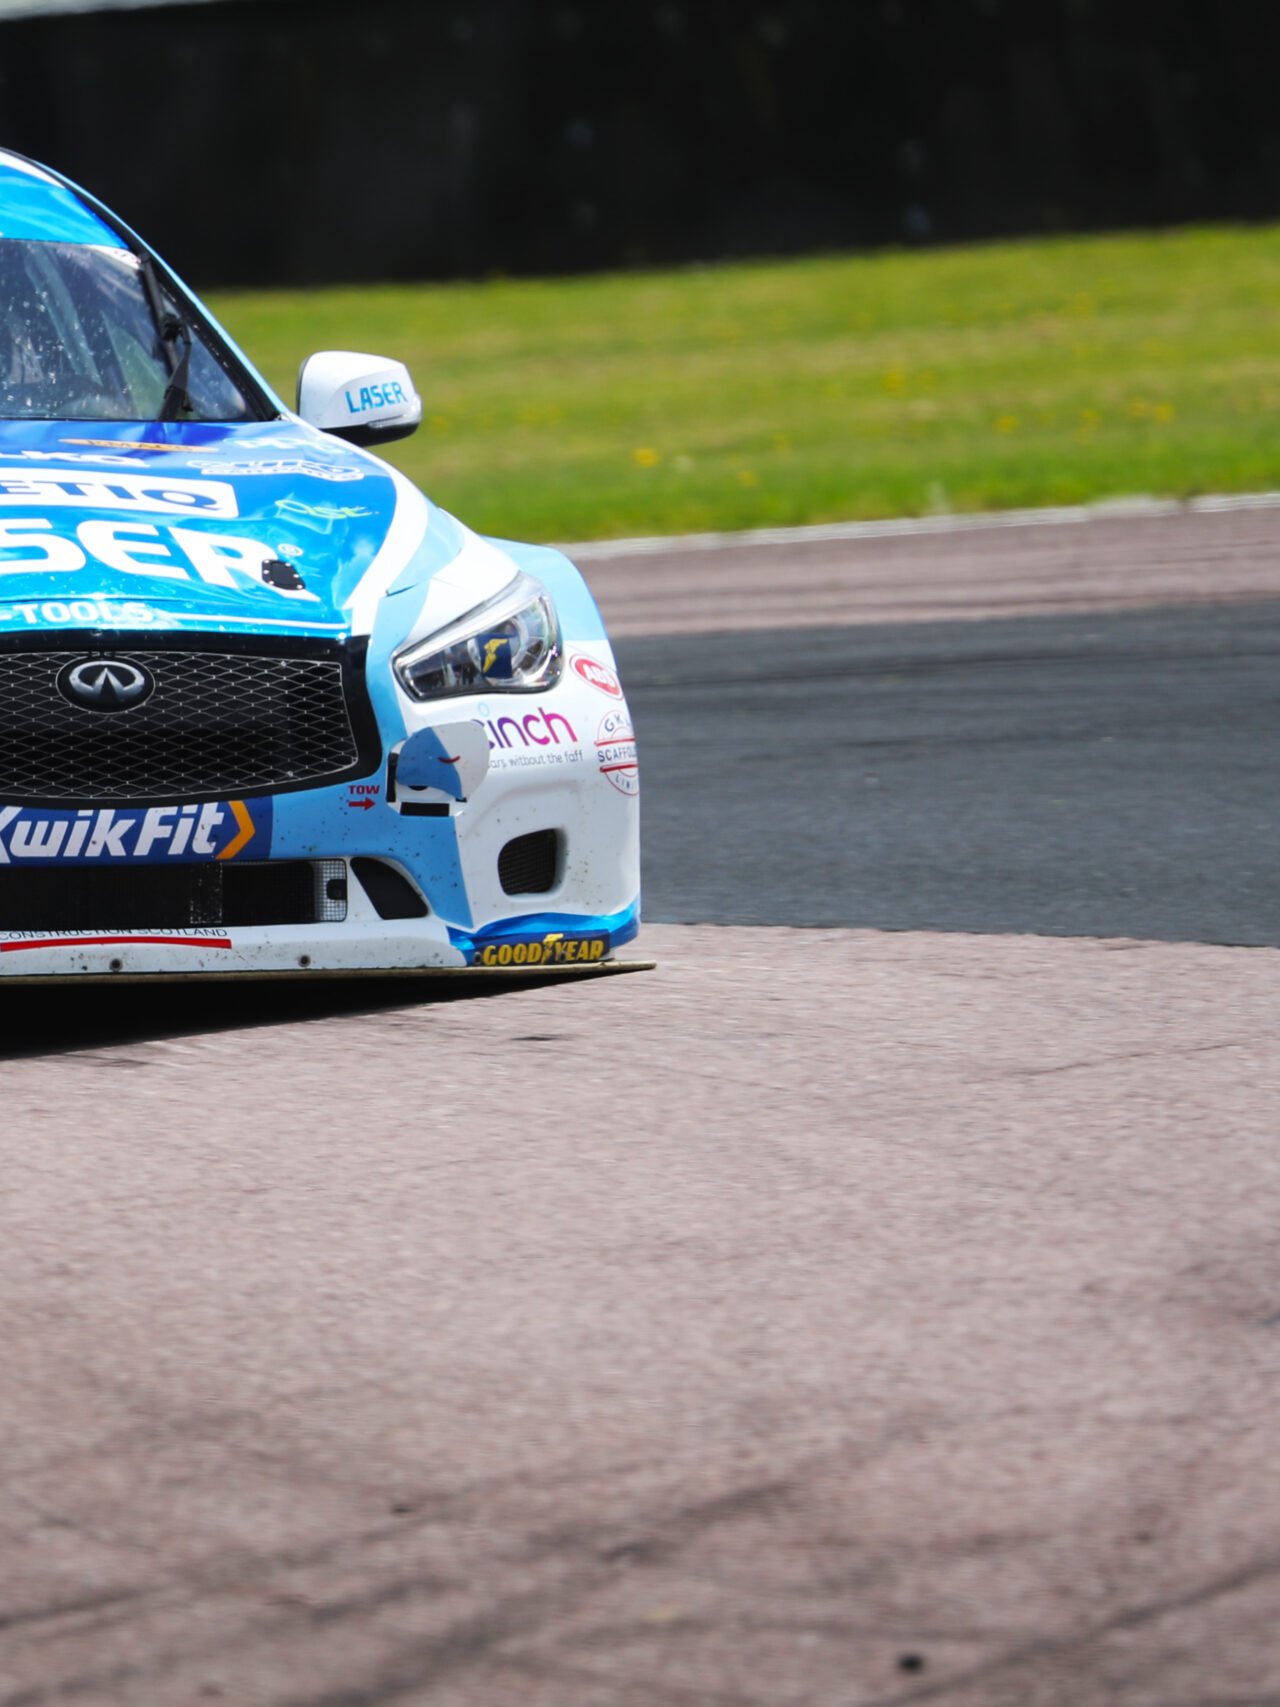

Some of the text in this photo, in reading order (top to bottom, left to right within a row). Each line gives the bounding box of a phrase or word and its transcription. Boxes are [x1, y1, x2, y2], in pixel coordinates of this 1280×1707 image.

[345, 382, 407, 413] LASER
[12, 602, 153, 624] TOOLS
[584, 663, 617, 690] ABS
[510, 754, 546, 767] without
[547, 753, 563, 764] the
[564, 750, 583, 762] faff
[349, 785, 380, 795] TOW
[139, 927, 228, 938] SCOTLAND
